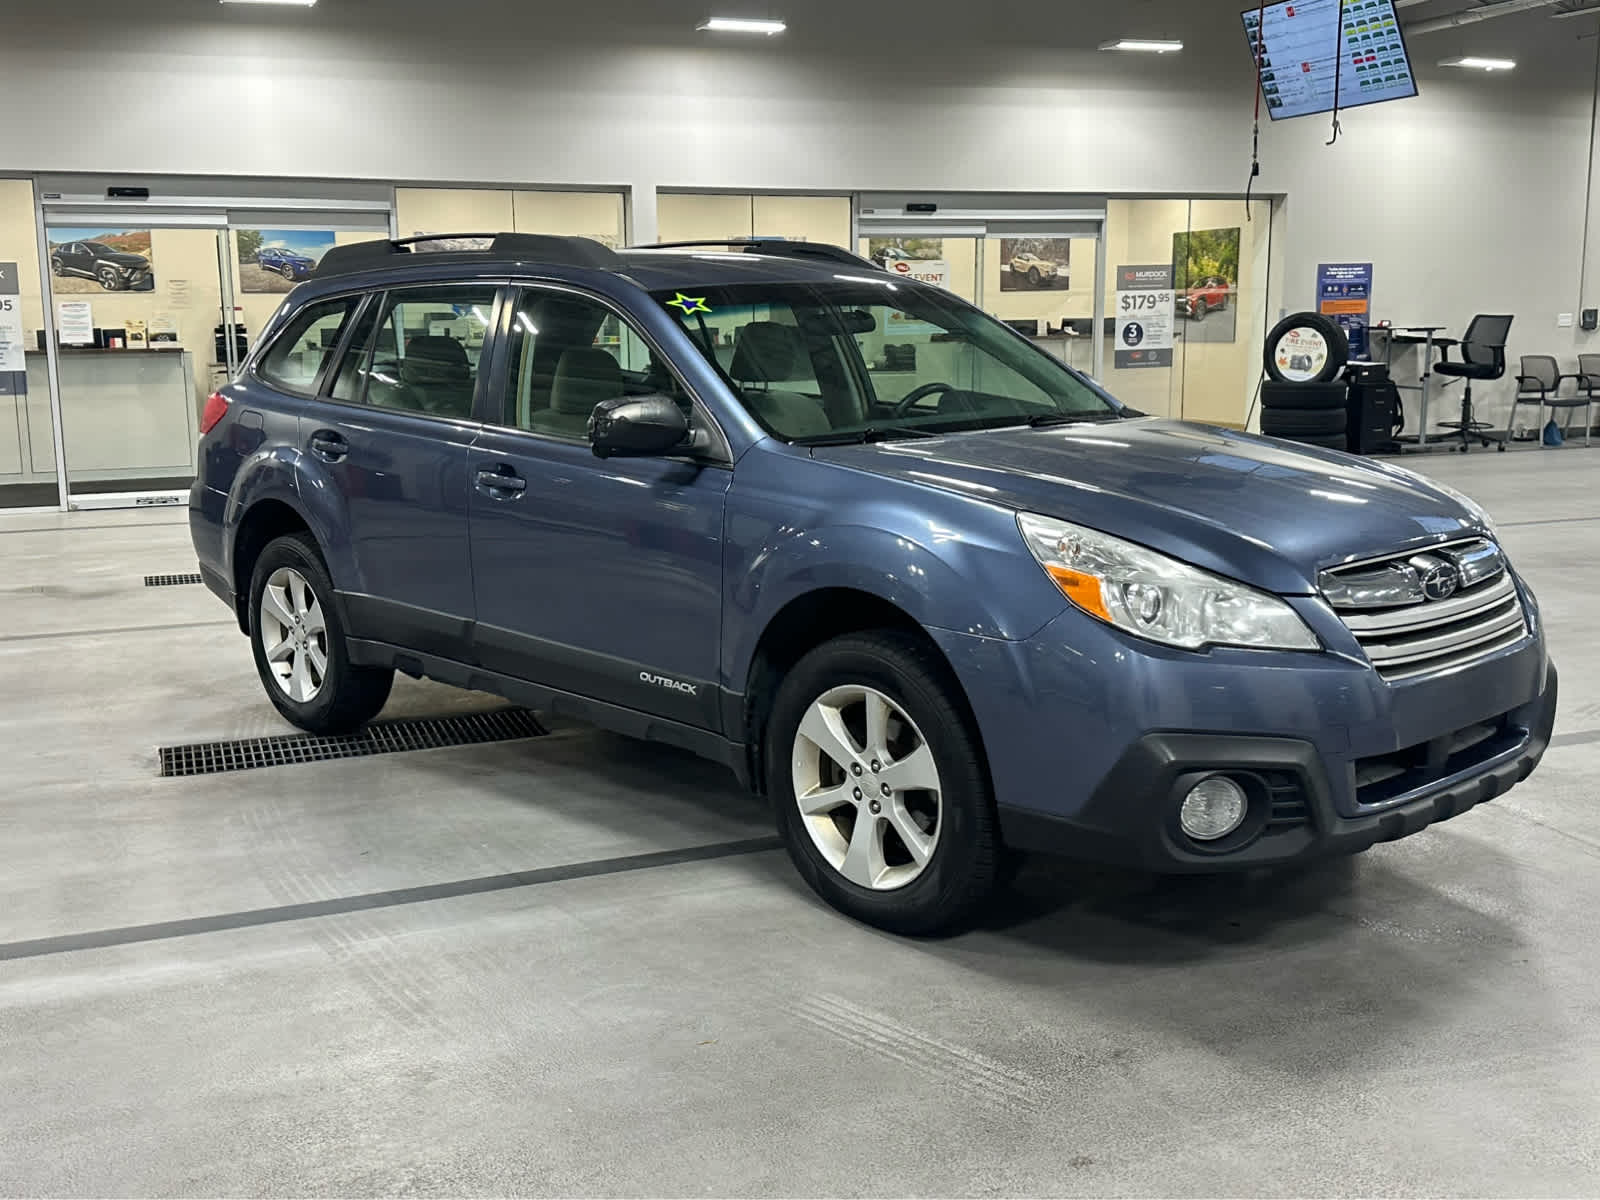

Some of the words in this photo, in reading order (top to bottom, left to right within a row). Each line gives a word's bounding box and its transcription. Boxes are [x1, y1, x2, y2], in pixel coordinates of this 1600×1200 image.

[914, 273, 944, 281] EVENT
[1128, 324, 1138, 338] 3
[640, 671, 696, 695] OUTBACK
